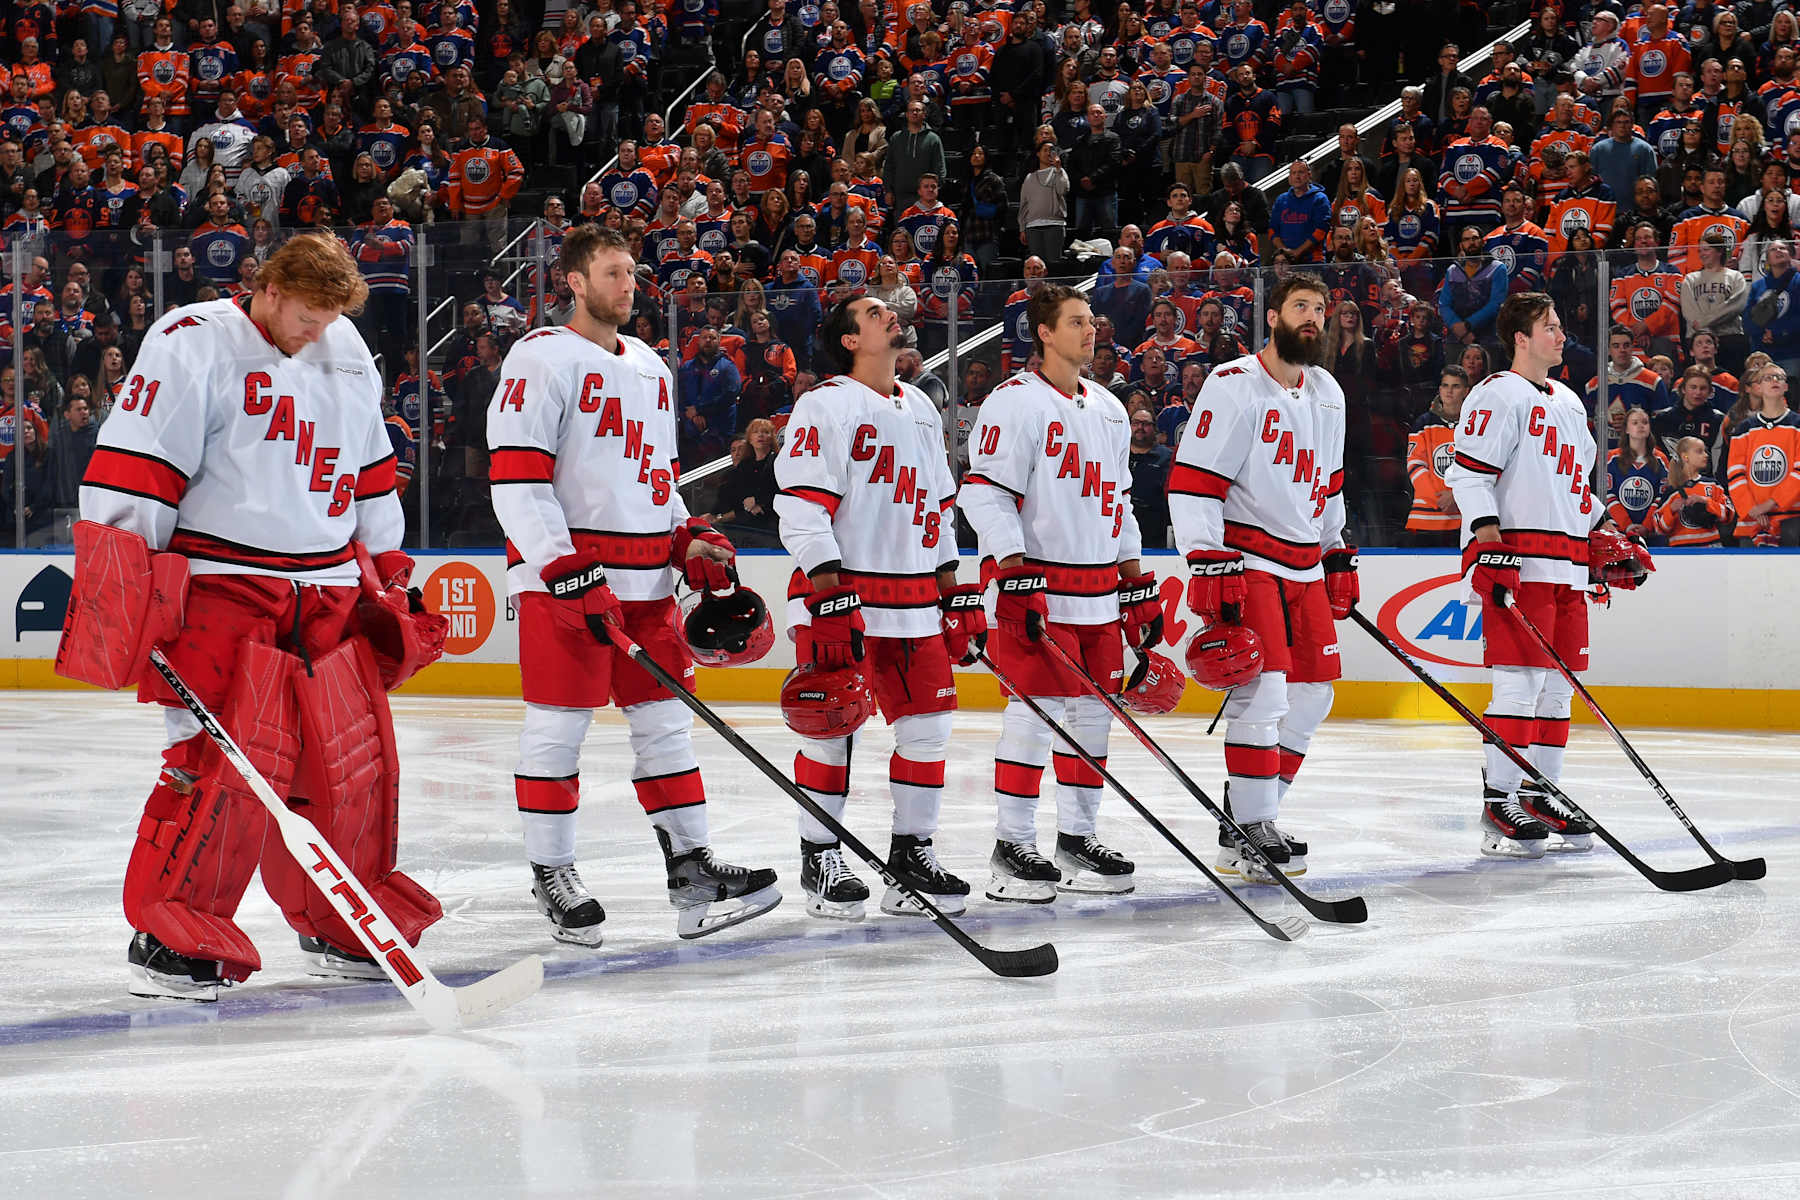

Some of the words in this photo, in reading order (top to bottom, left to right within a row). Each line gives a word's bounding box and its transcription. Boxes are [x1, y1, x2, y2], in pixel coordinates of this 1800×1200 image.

[121, 374, 161, 417] 31
[657, 376, 669, 411] A
[579, 373, 671, 506] CANES
[1195, 410, 1213, 439] 8
[1464, 409, 1492, 436] 37
[244, 371, 356, 518] CANES
[790, 426, 820, 457] 24
[1528, 405, 1593, 515] CANES
[1754, 461, 1782, 471] OILERS
[851, 424, 941, 549] CANES
[1045, 421, 1124, 538] CANES
[1624, 488, 1649, 498] OILERS
[1190, 558, 1244, 576] CCM
[1478, 553, 1523, 567] BAUE
[439, 577, 477, 612] 1ST
[1003, 577, 1047, 591] BAU
[819, 593, 862, 616] BAU
[160, 787, 204, 881] TRUE
[307, 842, 425, 988] TRUE
